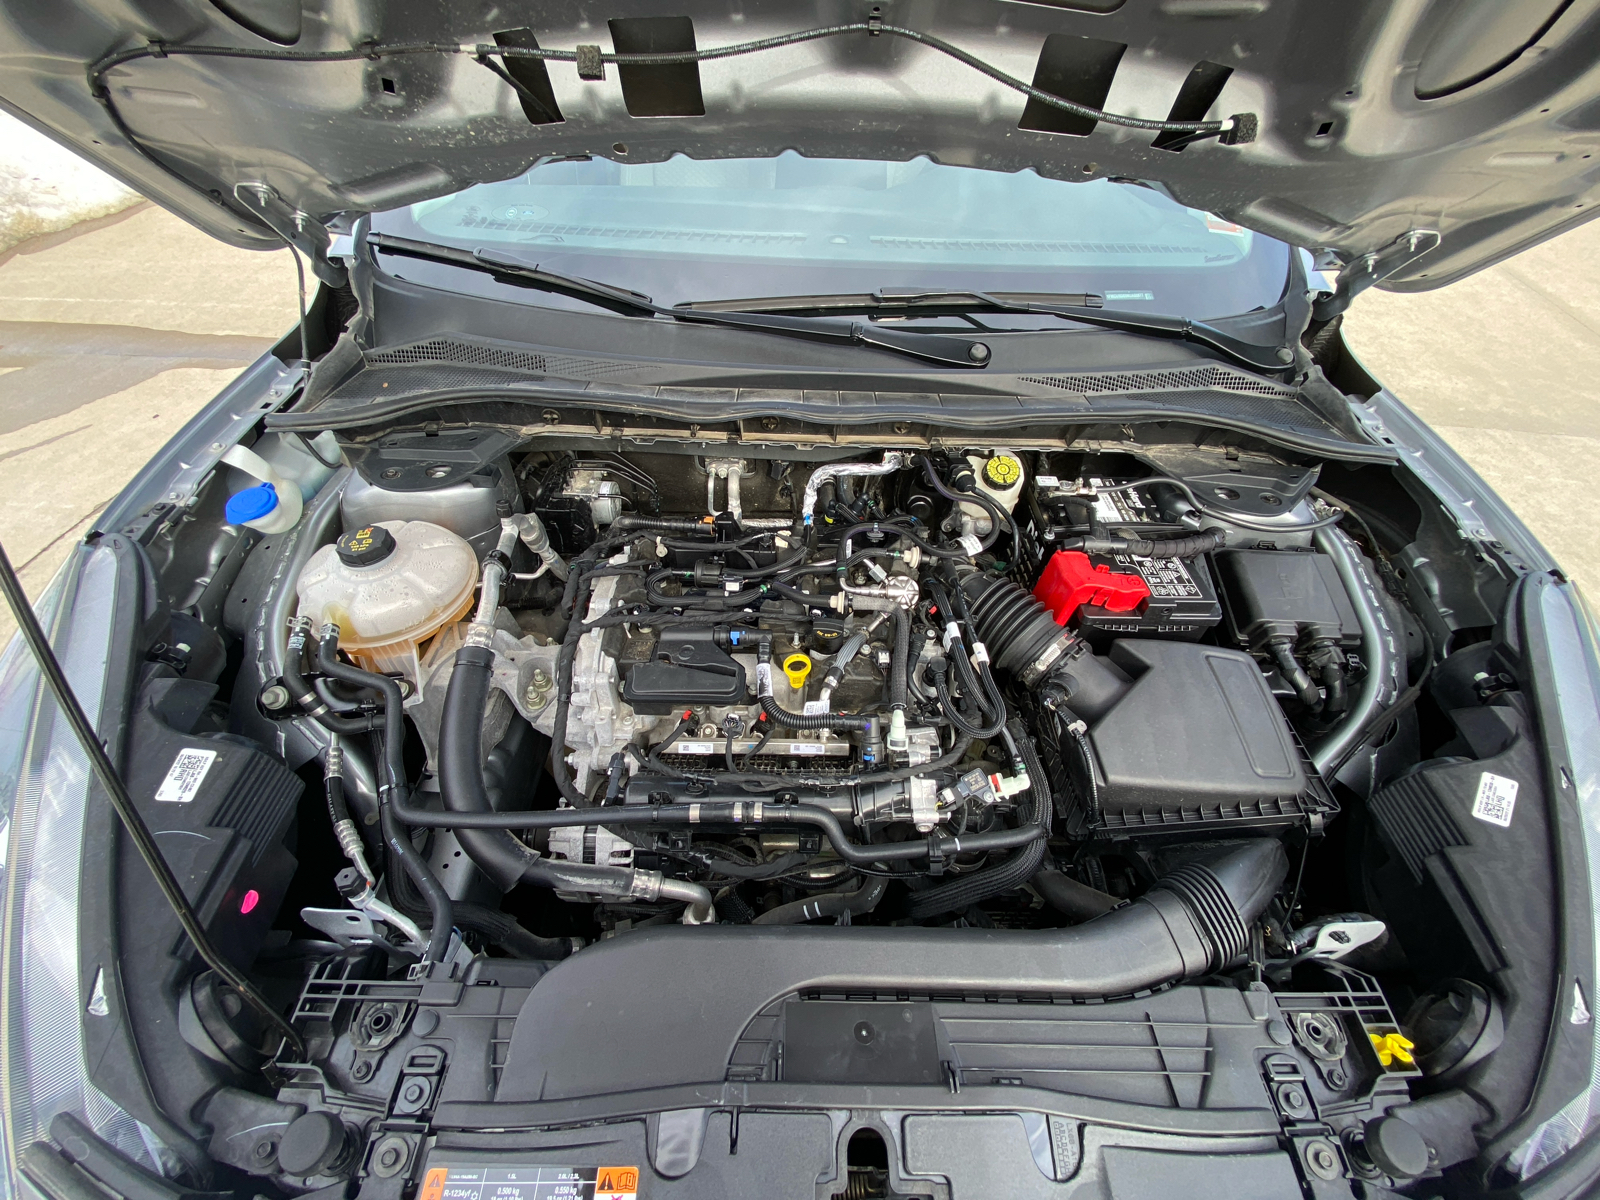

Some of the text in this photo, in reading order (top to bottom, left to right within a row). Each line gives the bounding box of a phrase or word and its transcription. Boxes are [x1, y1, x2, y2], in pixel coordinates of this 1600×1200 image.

[443, 1189, 472, 1198] R-1234yf
[497, 1187, 520, 1196] 0.500 kg
[570, 1186, 577, 1196] kg
